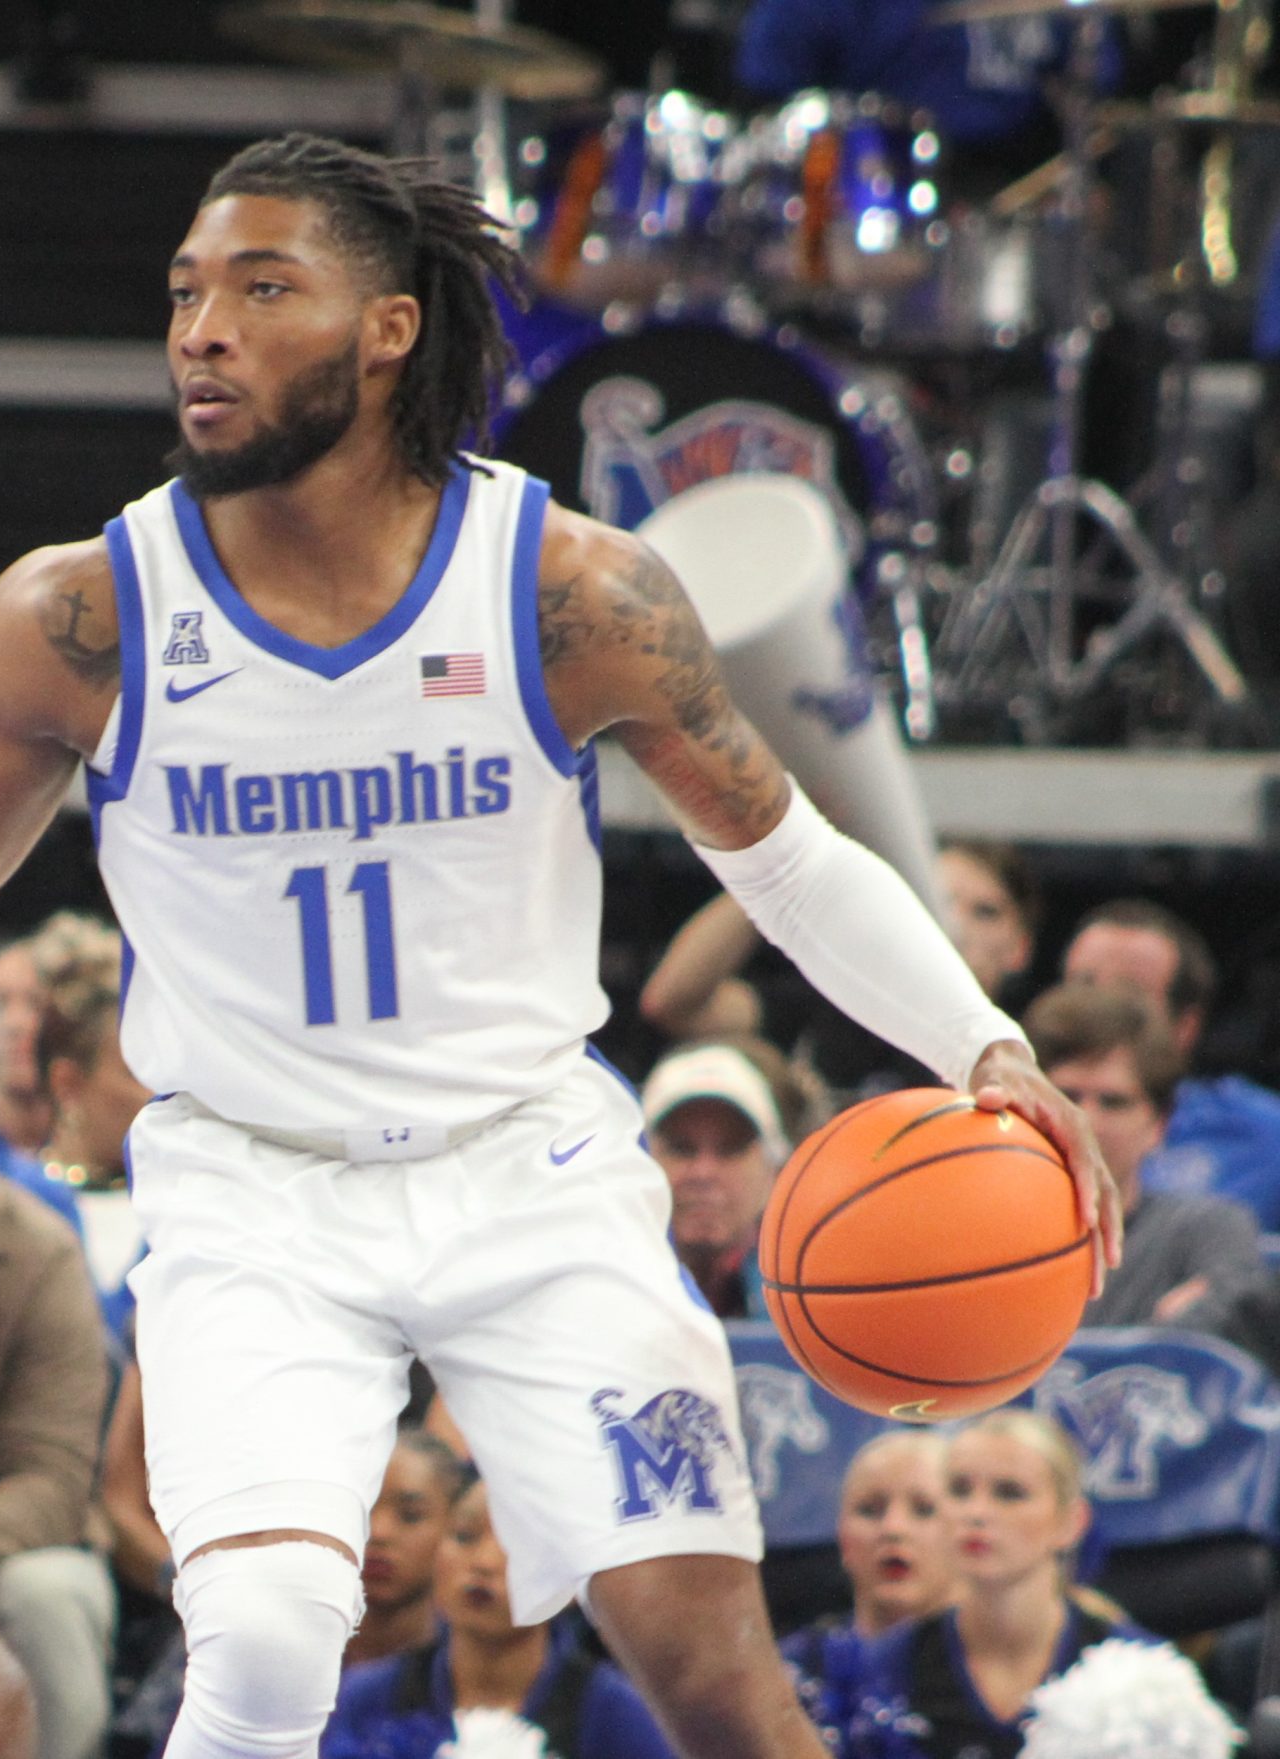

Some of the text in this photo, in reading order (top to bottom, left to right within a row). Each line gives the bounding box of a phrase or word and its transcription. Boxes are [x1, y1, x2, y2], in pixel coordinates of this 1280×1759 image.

[158, 746, 514, 840] Memphis
[282, 860, 401, 1027] 11
[596, 1416, 724, 1526] M
